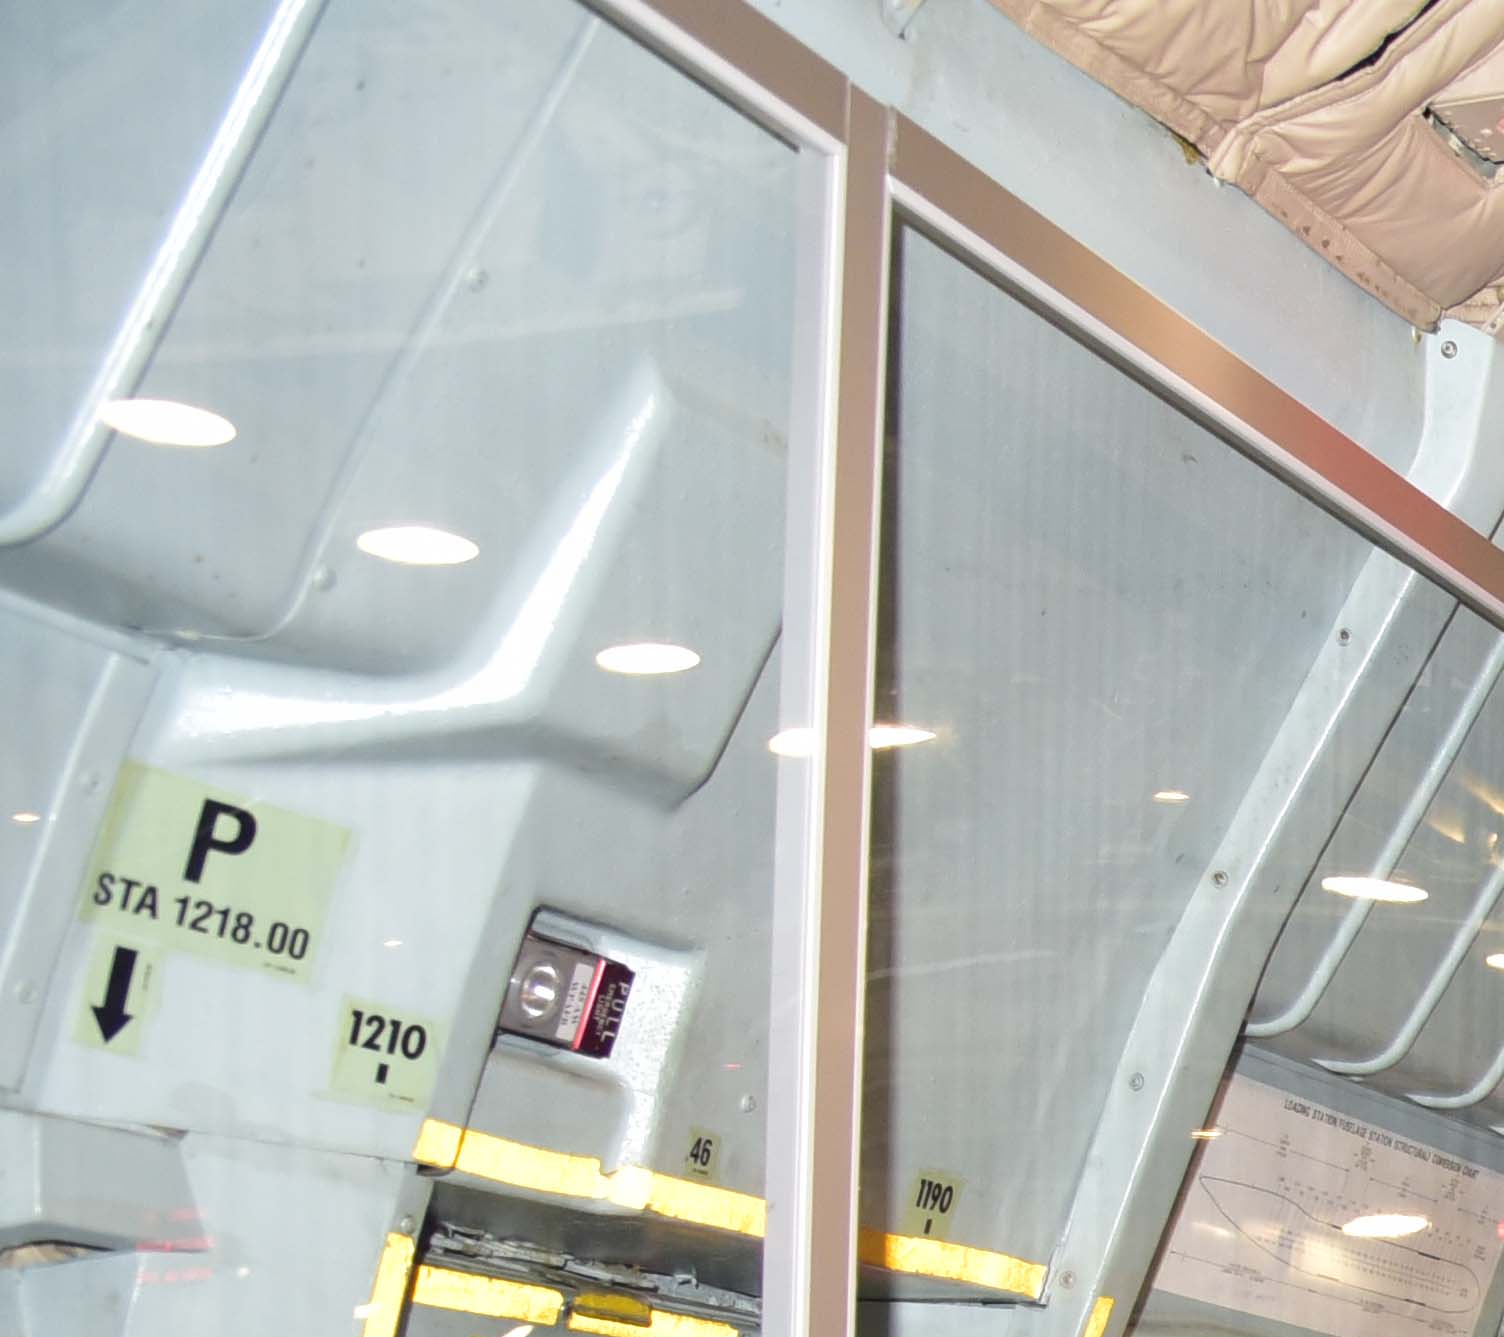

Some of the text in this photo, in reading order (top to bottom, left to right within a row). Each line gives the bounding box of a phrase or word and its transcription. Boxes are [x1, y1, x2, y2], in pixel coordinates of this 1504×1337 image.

[184, 798, 257, 884] P
[93, 872, 310, 960] STA 1218.00
[349, 1009, 427, 1060] 1210
[600, 981, 631, 1042] PULL
[689, 1136, 713, 1166] 46
[915, 1179, 953, 1214] 1190
